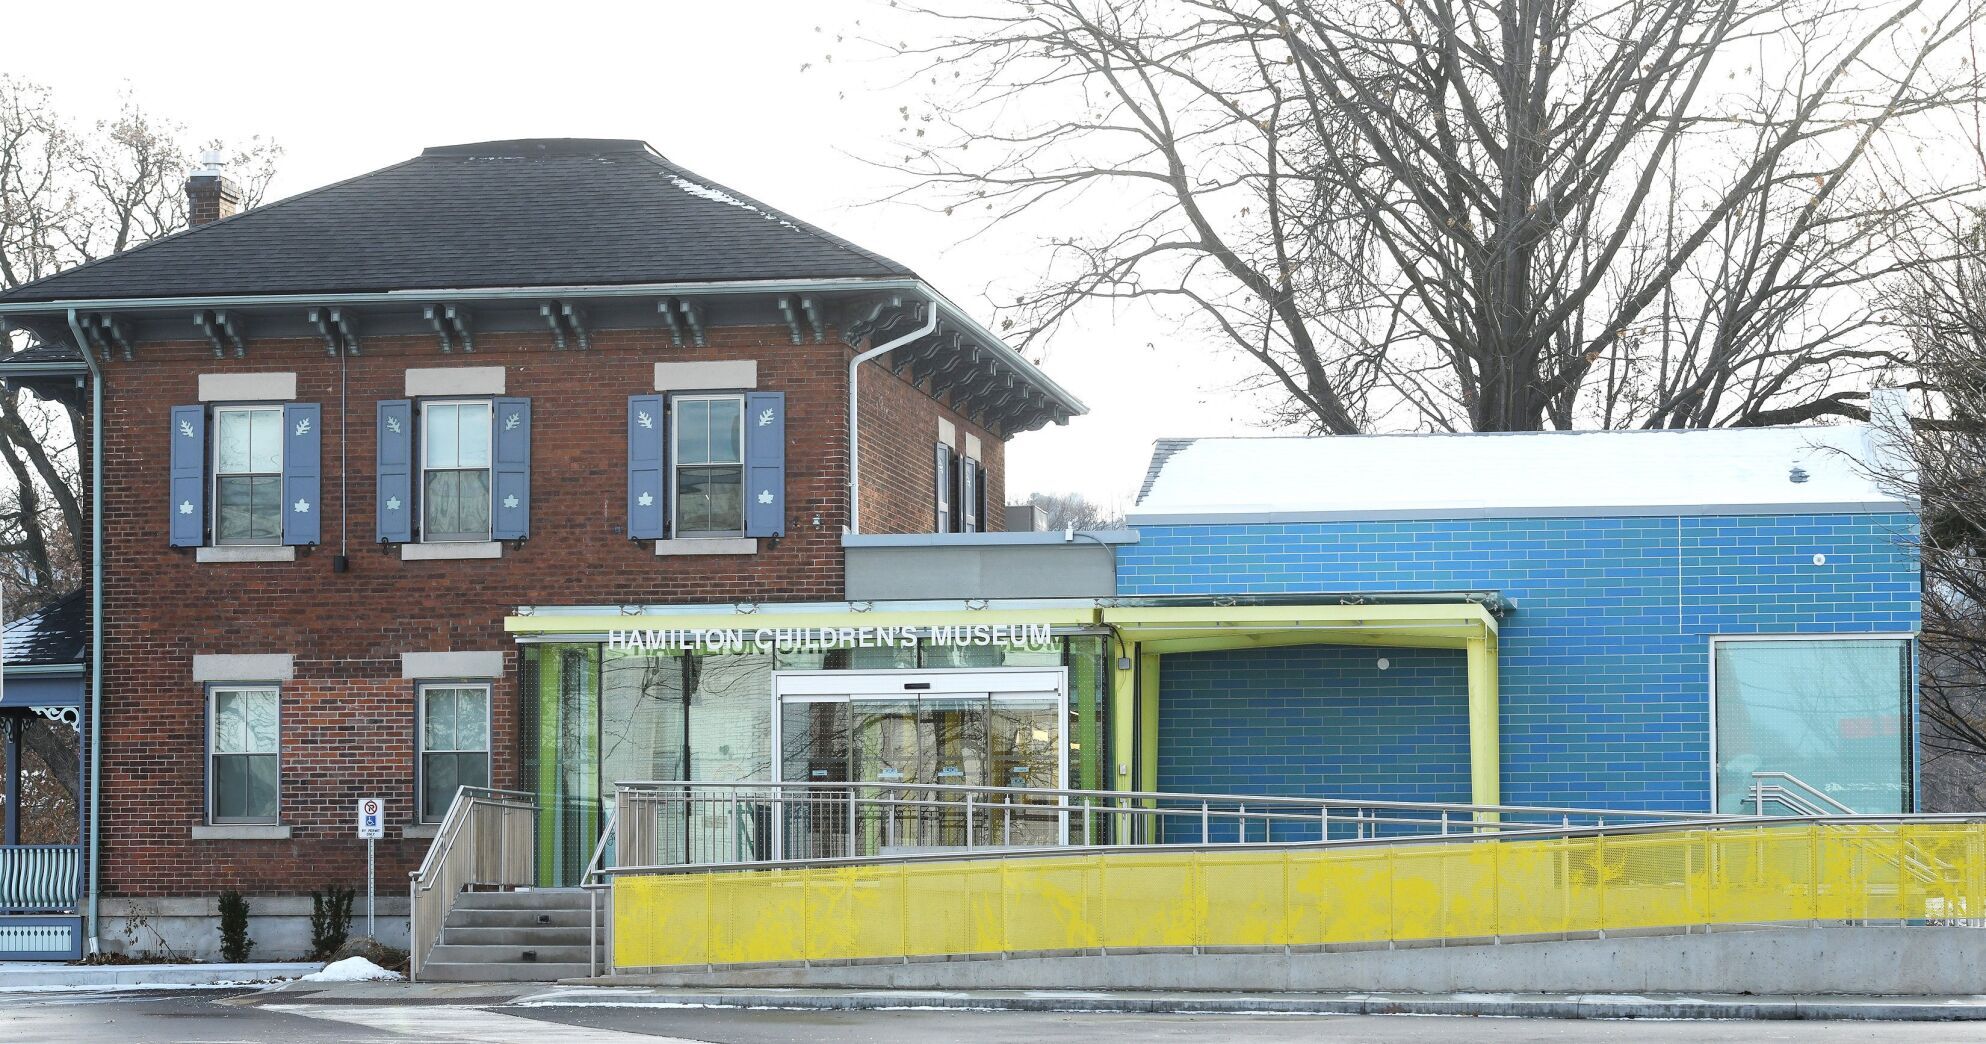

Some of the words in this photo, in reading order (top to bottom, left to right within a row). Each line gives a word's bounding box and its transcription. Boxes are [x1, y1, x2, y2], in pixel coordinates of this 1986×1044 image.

[608, 629, 743, 650] HAMILTON
[754, 626, 917, 649] CHILDREN'S
[931, 623, 1051, 646] MUSEUM
